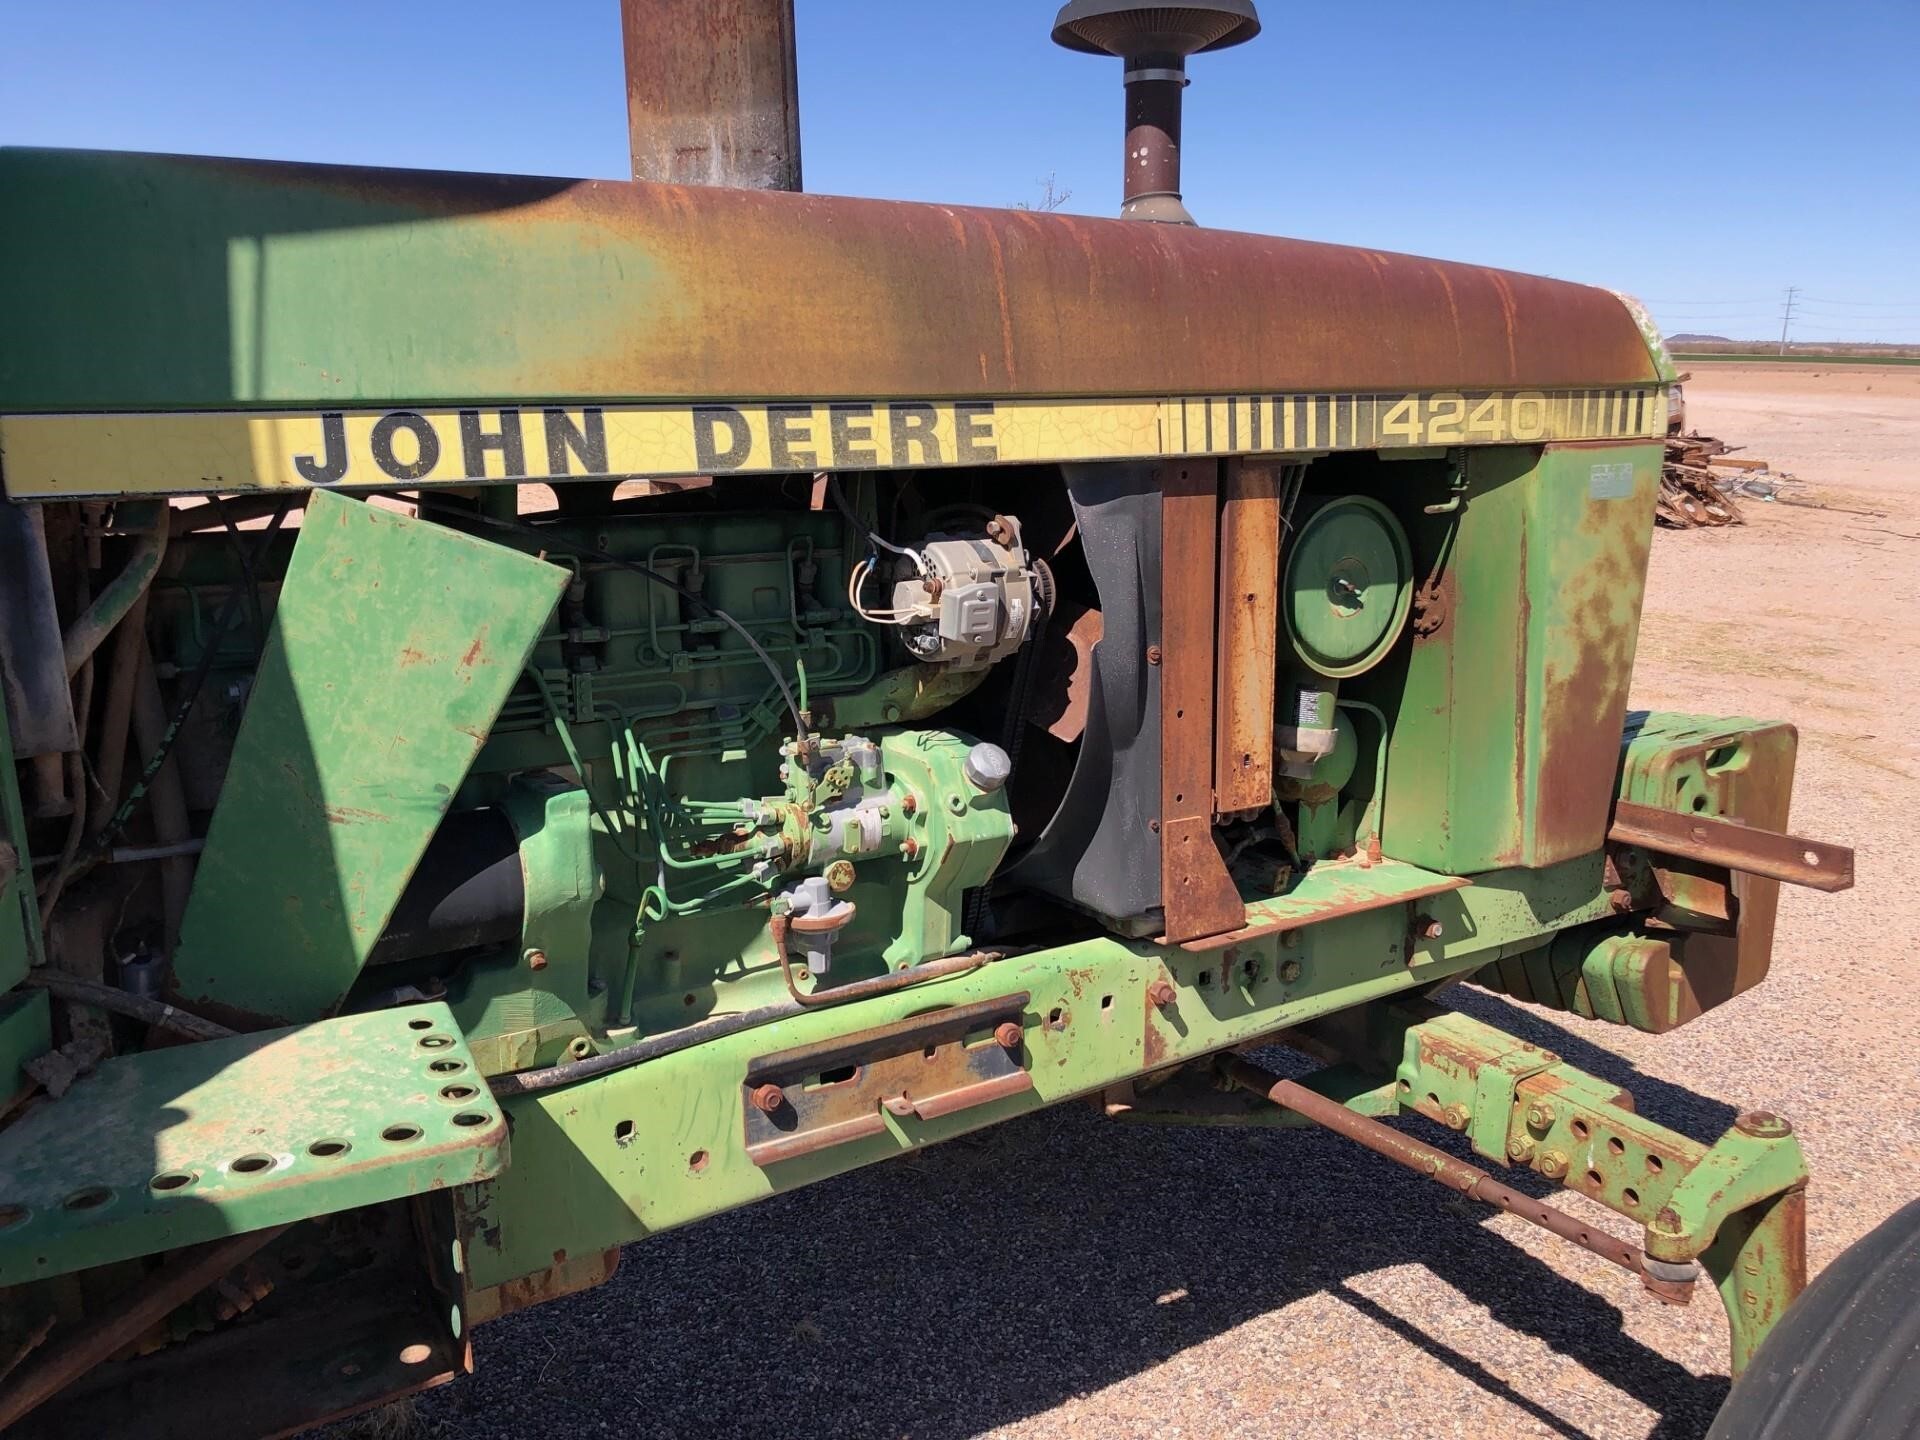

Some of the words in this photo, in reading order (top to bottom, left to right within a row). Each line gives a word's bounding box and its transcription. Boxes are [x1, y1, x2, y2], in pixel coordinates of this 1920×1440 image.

[294, 408, 608, 484] JOHN
[693, 402, 999, 474] DEERE
[1382, 391, 1547, 443] 4240
